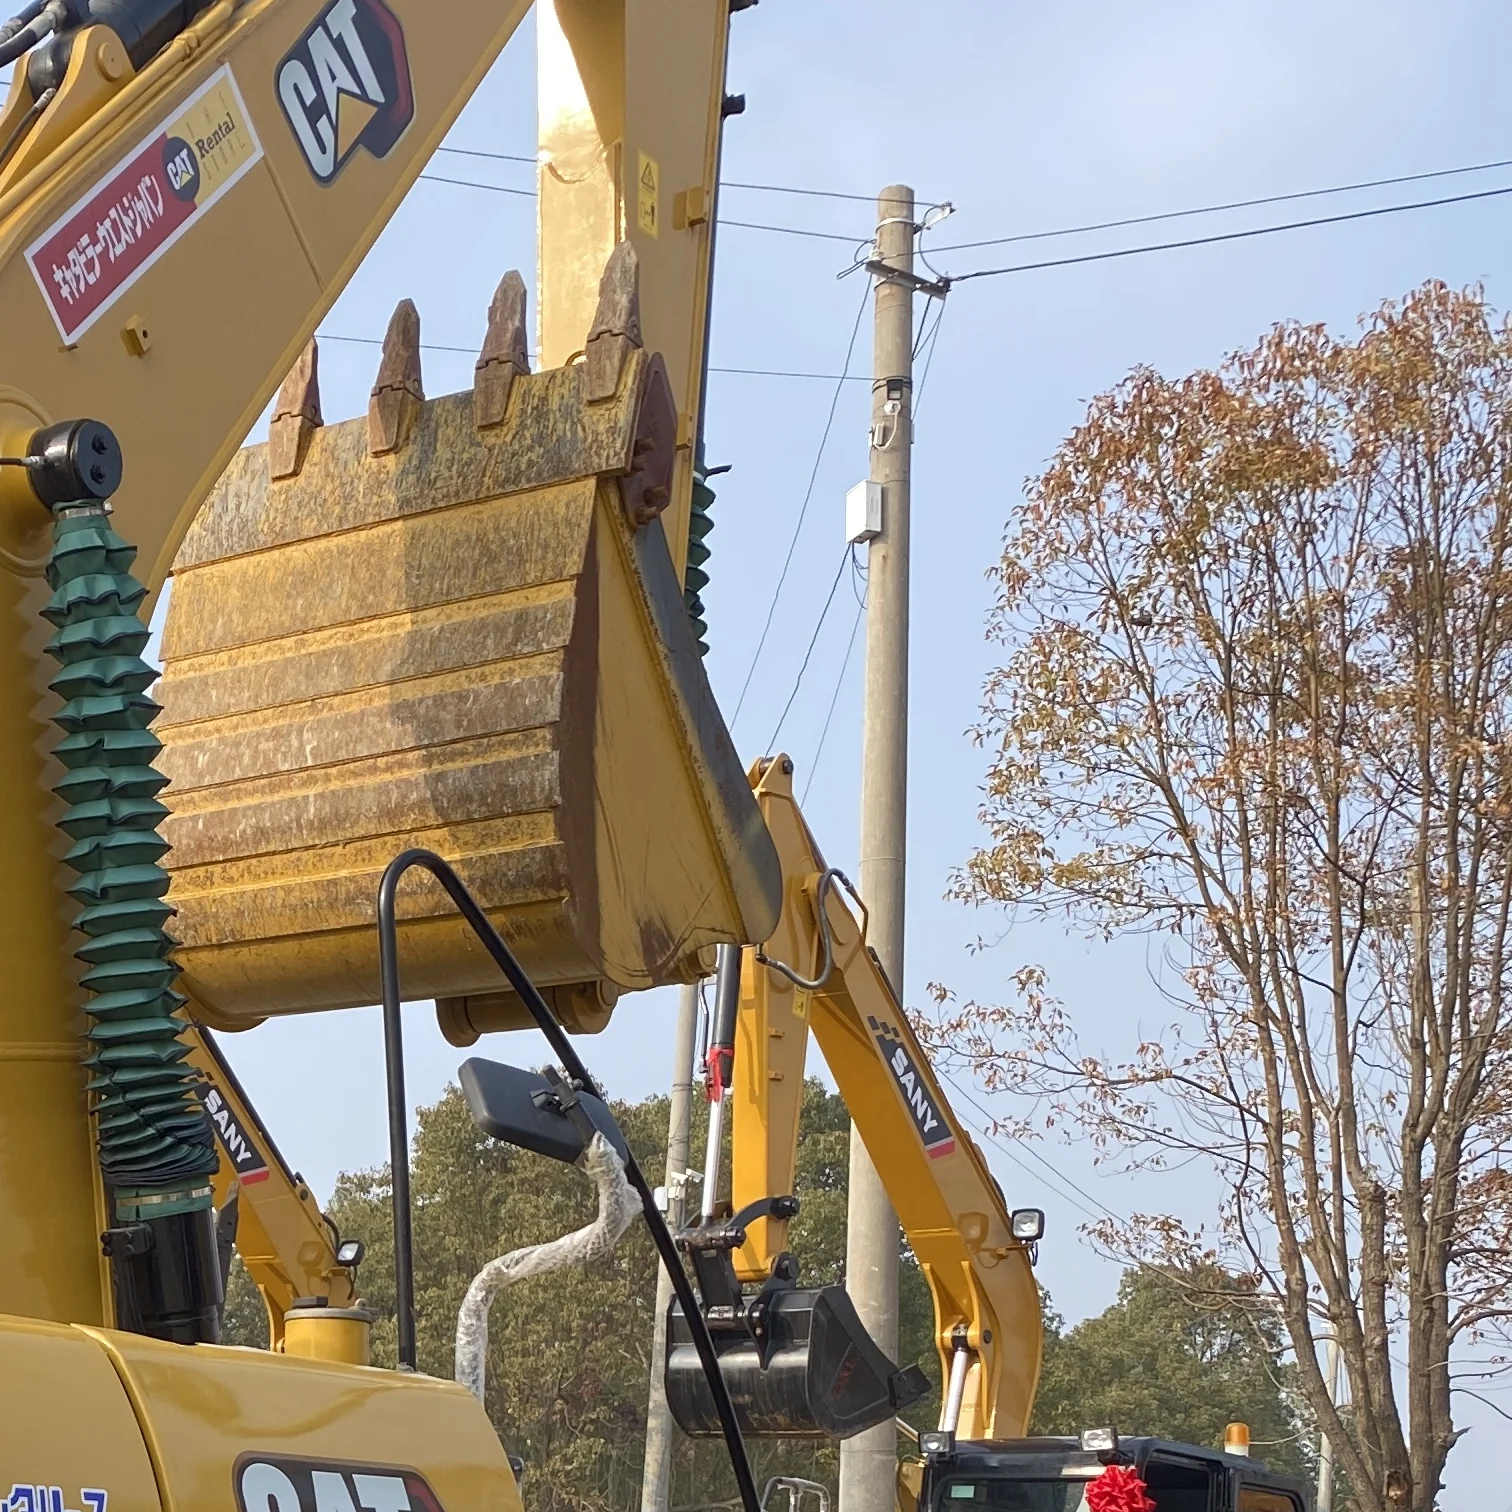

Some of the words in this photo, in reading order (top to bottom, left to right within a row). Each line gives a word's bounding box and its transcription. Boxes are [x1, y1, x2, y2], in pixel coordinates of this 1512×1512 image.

[279, 0, 385, 177] CAT
[167, 147, 194, 191] CAT
[194, 111, 236, 160] Rental
[204, 1089, 252, 1163] SANY
[891, 1048, 938, 1133] SANY
